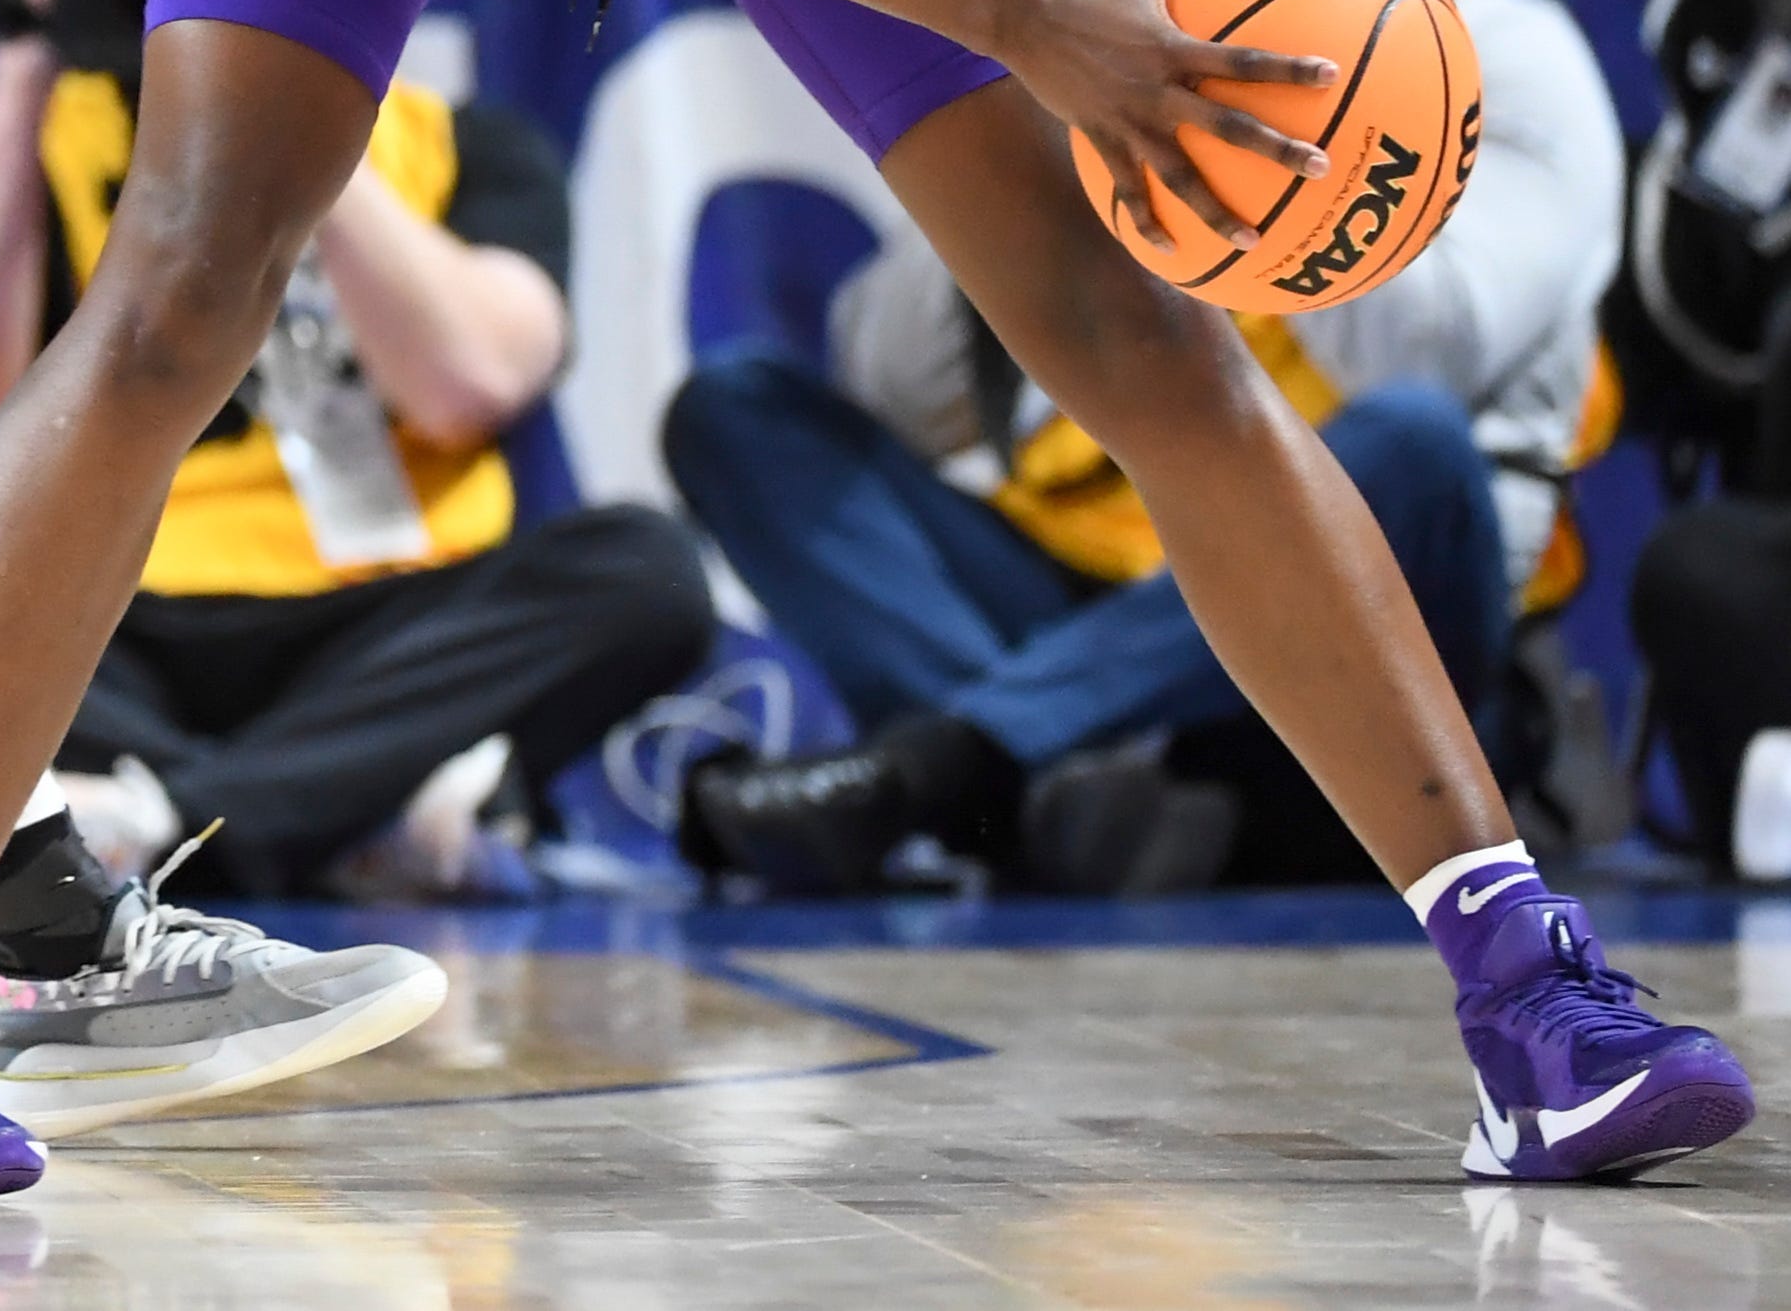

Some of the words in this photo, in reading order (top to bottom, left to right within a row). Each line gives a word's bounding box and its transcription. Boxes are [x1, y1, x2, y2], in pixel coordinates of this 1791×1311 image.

[1333, 125, 1375, 205] OFFICIAL
[1269, 132, 1421, 296] NCAA
[1294, 210, 1334, 251] GAME
[1254, 253, 1296, 279] BALL
